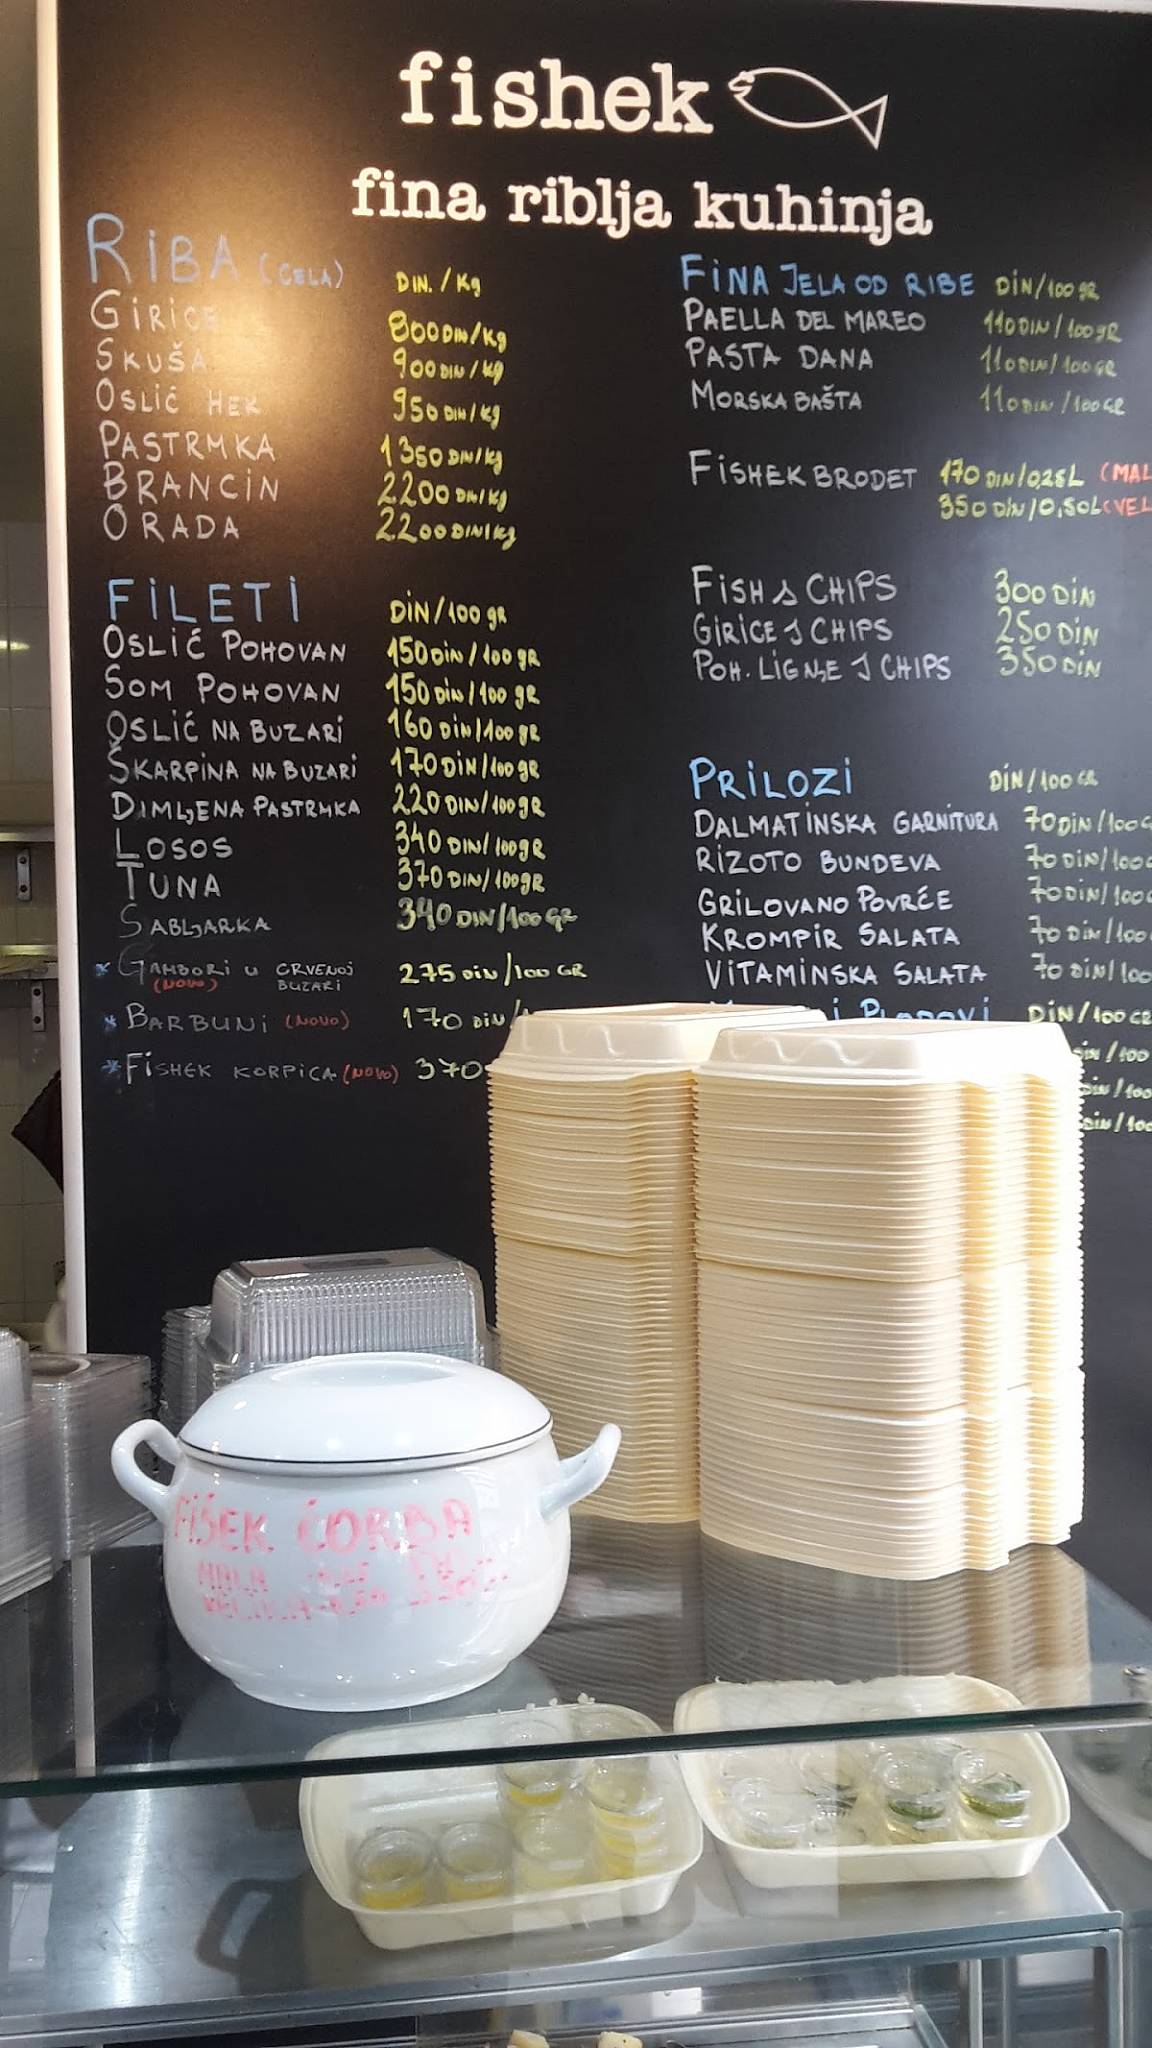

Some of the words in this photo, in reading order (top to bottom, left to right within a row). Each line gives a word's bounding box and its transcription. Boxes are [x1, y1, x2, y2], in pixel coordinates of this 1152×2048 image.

[399, 50, 714, 134] fishek
[351, 166, 486, 222] fina
[507, 175, 672, 240] riblja
[692, 180, 933, 246] kuhinja
[854, 274, 888, 296] OD
[904, 271, 975, 298] RIBE
[683, 297, 785, 332] PAELLA
[796, 309, 836, 332] DEL
[844, 310, 926, 334] MAREO
[684, 336, 782, 371] PASTA
[798, 344, 874, 370] DANA
[690, 378, 788, 411] MORSKA
[794, 384, 863, 412] BAŠTA
[99, 419, 276, 463] PASTRMKA
[812, 464, 918, 492] BRODET
[103, 503, 240, 543] ORADA
[938, 493, 987, 520] 350
[806, 570, 898, 605] CHIPS
[995, 568, 1046, 605] 300
[810, 616, 893, 645] CHIPS
[995, 606, 1051, 645] 250
[221, 629, 347, 663] POHOVAN
[996, 644, 1057, 677] 350
[104, 663, 173, 700] SOM
[197, 672, 341, 703] POHOVAN
[880, 652, 951, 682] CHIPS
[385, 671, 430, 706] 150
[211, 719, 241, 742] NA
[387, 706, 433, 740] 160
[251, 761, 277, 781] NA
[390, 747, 438, 778] 170
[253, 795, 361, 819] PASTRMKA
[392, 782, 441, 816] 220
[1023, 805, 1057, 832] 70
[115, 828, 233, 861] LOSOS
[395, 820, 442, 856] 340
[819, 850, 942, 875] BUNDEVA
[1024, 843, 1057, 870] 70
[115, 861, 222, 900] TUNA
[397, 856, 444, 892] 370
[1027, 875, 1063, 904] 70
[396, 897, 452, 932] 340
[1027, 914, 1062, 945] 70
[858, 922, 961, 948] SALATA
[399, 962, 458, 985] 275
[894, 961, 988, 985] SALATA
[1031, 953, 1063, 980] 70
[402, 1007, 463, 1030] 170
[415, 1057, 484, 1080] 370
